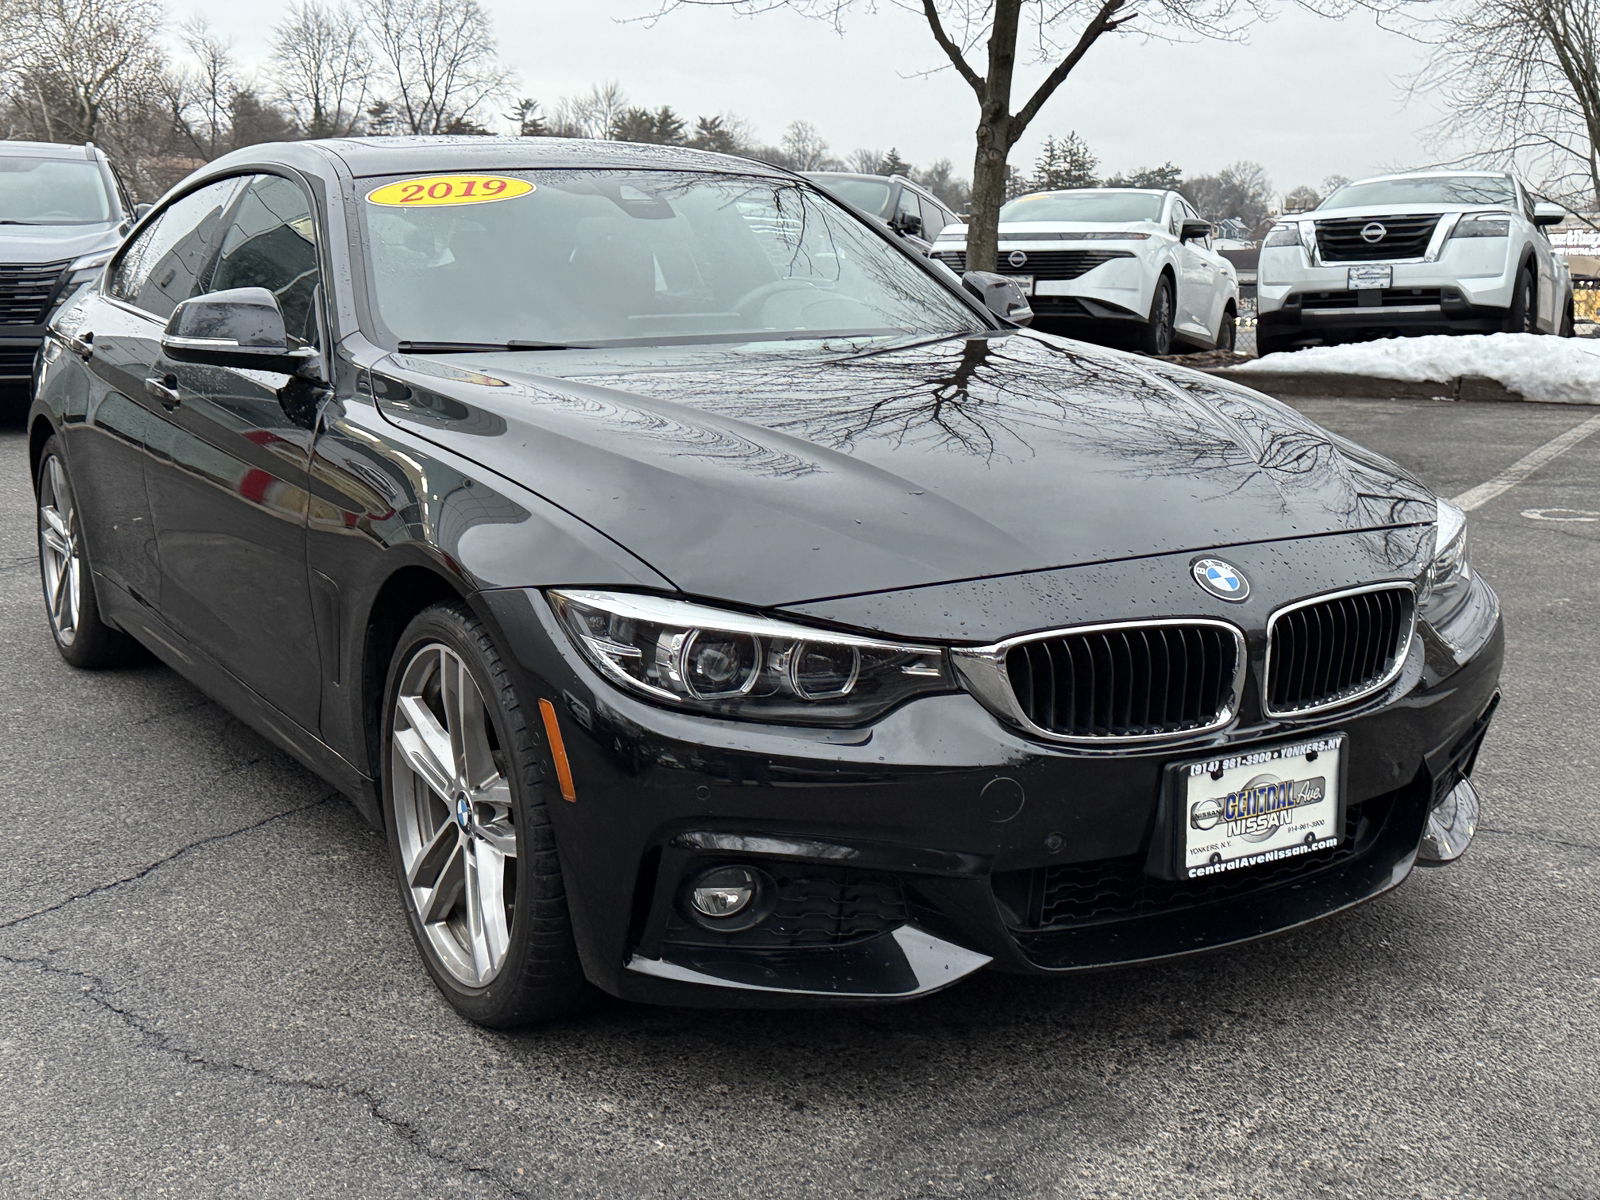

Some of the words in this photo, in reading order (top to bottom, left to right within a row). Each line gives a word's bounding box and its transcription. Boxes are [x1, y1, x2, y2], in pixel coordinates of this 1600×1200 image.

[400, 180, 507, 203] 2019
[1196, 559, 1233, 575] BMW
[1190, 761, 1220, 777] (914)
[1224, 779, 1296, 822] CENTRAL
[1194, 809, 1222, 820] NISSAN
[1227, 808, 1293, 838] NISSAN
